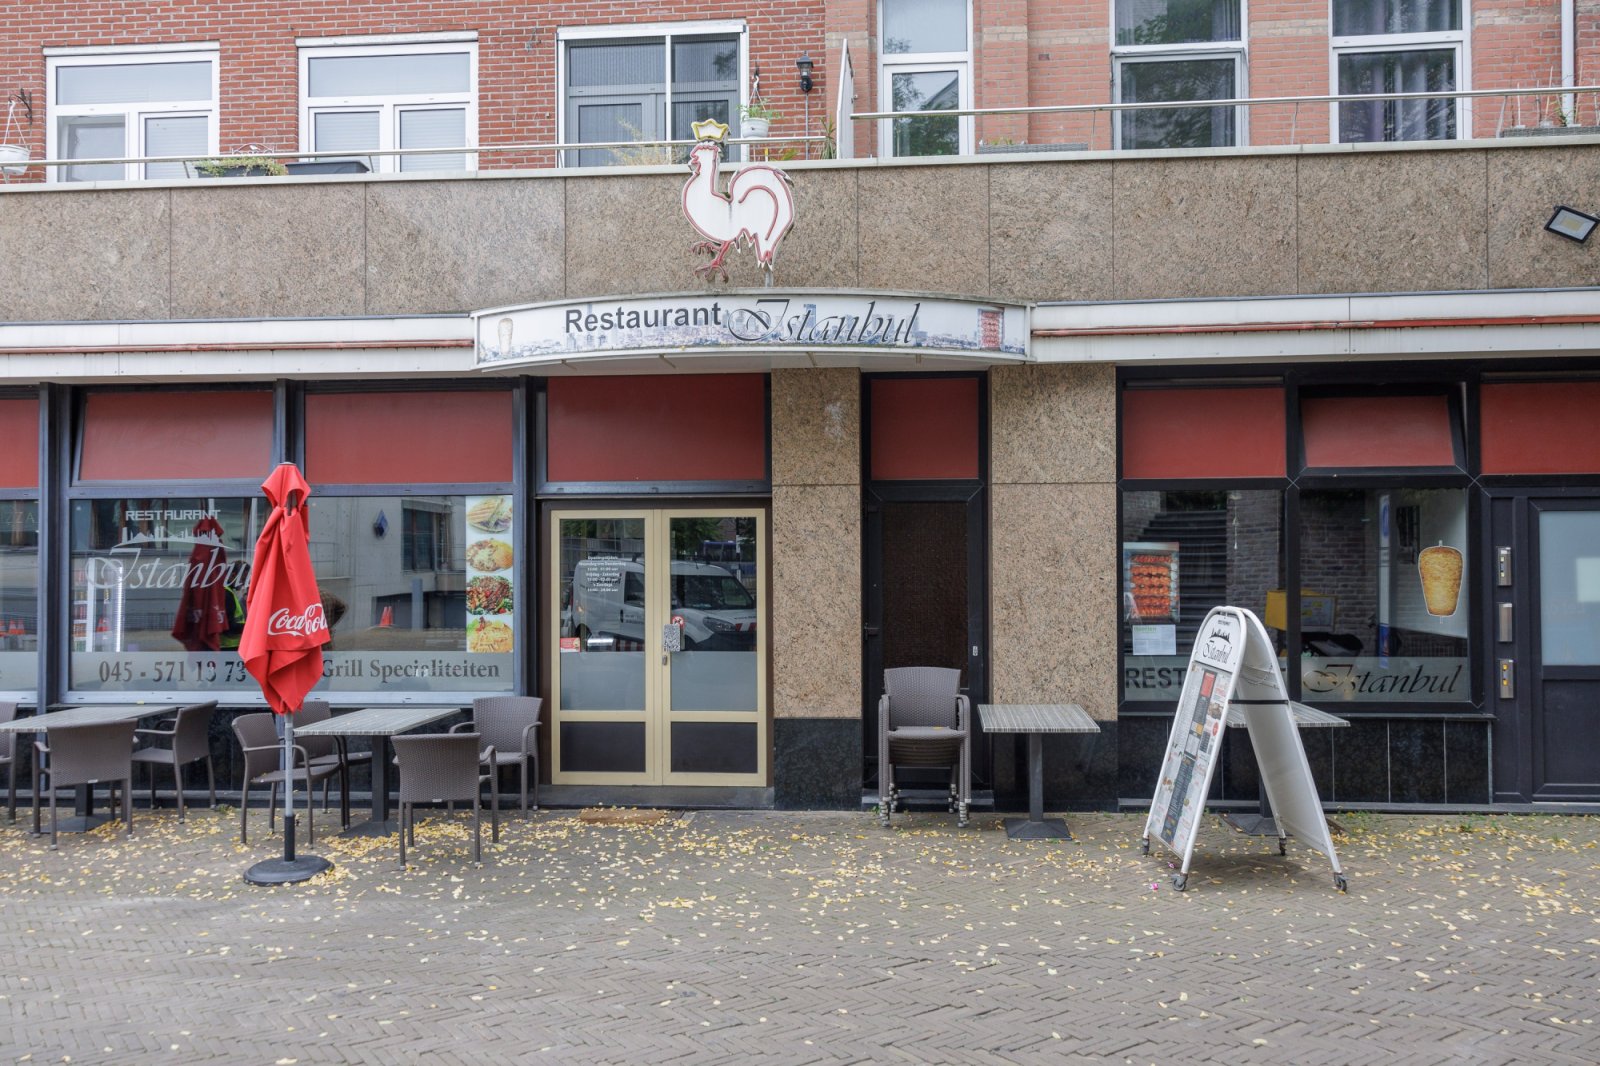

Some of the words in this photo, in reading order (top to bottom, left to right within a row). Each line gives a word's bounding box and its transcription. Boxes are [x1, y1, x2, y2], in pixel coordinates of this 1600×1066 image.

[565, 302, 721, 333] Restaurant
[728, 299, 920, 343] Istanbul
[125, 510, 221, 520] RESTAURANT
[85, 547, 249, 589] Istanbu
[99, 661, 132, 682] 045
[152, 661, 186, 682] 571
[196, 661, 217, 682] 13
[225, 661, 246, 682] 73
[322, 659, 363, 678] Grill
[370, 659, 500, 683] Specialiteiten
[1303, 664, 1462, 693] Istanbul
